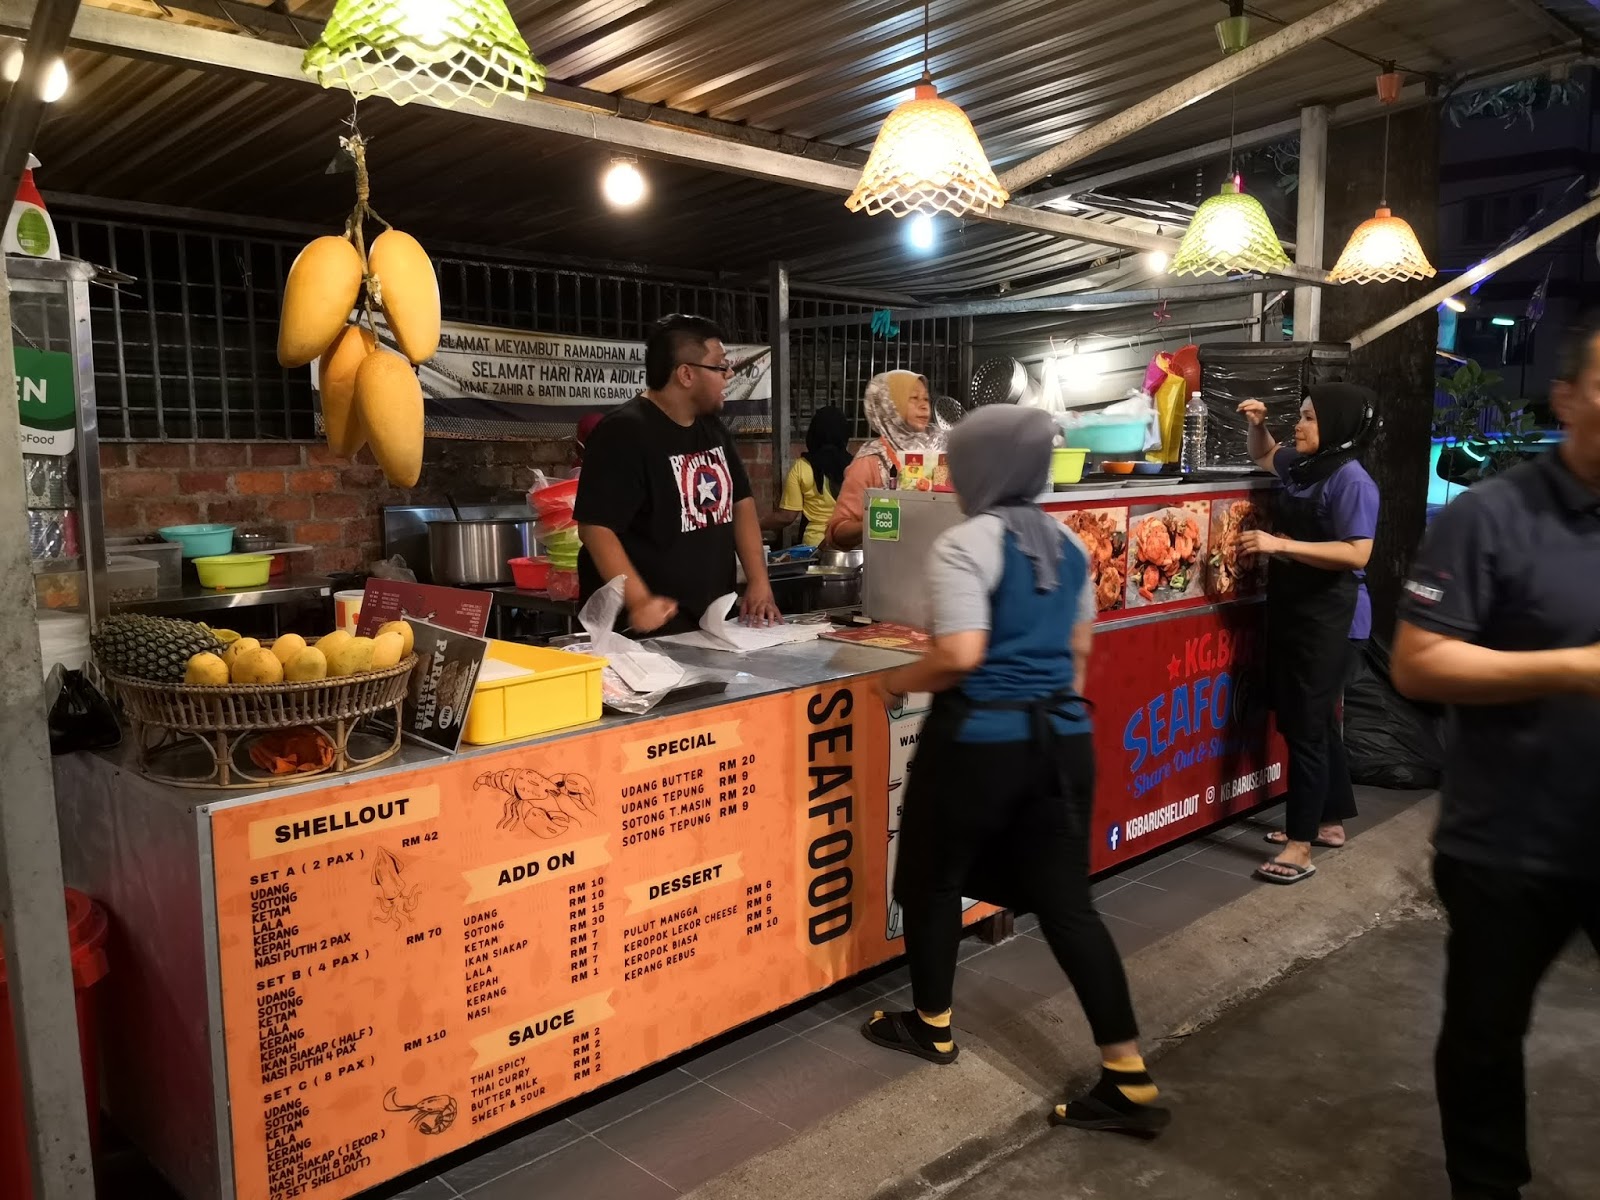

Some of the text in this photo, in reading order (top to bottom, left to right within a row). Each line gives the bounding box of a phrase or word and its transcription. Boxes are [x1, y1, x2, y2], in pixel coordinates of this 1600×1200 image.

[438, 334, 646, 361] ELAMAT MEYAMBUT RAMADHAN AL-
[472, 361, 646, 384] SELAMAT HARI RAYA AIDILF
[527, 384, 535, 397] &
[539, 385, 565, 398] BATIN
[568, 386, 592, 399] DARI
[876, 511, 893, 520] Grab
[876, 520, 893, 528] Food
[1185, 628, 1236, 677] KG.B
[415, 675, 431, 730] SERIES
[422, 639, 448, 730] PARATHA
[1123, 672, 1233, 774] SEAFO
[647, 733, 716, 759] SPECIAL
[622, 754, 755, 798] UDANG BUTTER RM 20
[622, 771, 748, 814] UDANG TEPUNG RM 9
[1133, 763, 1172, 798] Share
[1173, 750, 1196, 772] Out
[1221, 762, 1281, 802] KG.BARUSEAFOOD
[275, 799, 409, 843] SHELLOUT
[622, 785, 756, 830] SOTONG T.MASIN RM 20
[622, 801, 749, 846] SOTONG TEPUNG RM 9
[807, 688, 854, 946] SEAFOOD
[1126, 794, 1200, 842] KGBARUSHELLOUT
[250, 832, 438, 885] SET PAX RM 42
[498, 851, 575, 886] ADD ON
[251, 883, 290, 901] UDANG
[251, 892, 297, 912] SOTONG
[464, 877, 604, 926] UDANG RM 10
[649, 864, 723, 900] DESSERT
[252, 906, 291, 924] KETAM
[253, 919, 284, 935] LALA
[464, 890, 604, 940] SOTONG RM 10
[464, 902, 604, 954] KETAM RM 15
[624, 884, 761, 939] PULUT MANGGA RM
[624, 898, 762, 953] KEROPOK LEKOR CHEESE RM
[254, 925, 299, 946] KERANG
[254, 940, 290, 958] KEPAH
[255, 933, 351, 969] NASI PUTIH PAX
[465, 915, 605, 967] IKAN SIAKAP RM 30
[466, 933, 586, 980] LALA RM
[625, 910, 762, 967] KEROPOK BIASA RM
[625, 917, 778, 981] KERANG REBUS RM 10
[257, 928, 442, 990] SET PAX RM 70
[466, 946, 587, 994] KEPAH RM
[257, 987, 296, 1007] UDANG
[466, 958, 587, 1007] KERANG RM
[468, 971, 588, 1021] NASI RM
[258, 997, 303, 1018] SOTONG
[258, 1010, 296, 1029] KETAM
[508, 1010, 575, 1046] SAUCE
[259, 1023, 289, 1040] LALA
[260, 1029, 305, 1051] KERANG
[260, 1042, 296, 1063] KEPAH
[261, 1030, 365, 1073] IKAN SIAKAP HALF
[262, 1043, 356, 1084] NASI PUTIH PAX
[264, 1030, 447, 1104] SET PAX RM 110
[471, 1032, 589, 1084] THAI SPICY RM
[471, 1044, 590, 1098] THAI CURRY RM
[472, 1056, 590, 1112] BUTTER MILK RM
[472, 1068, 590, 1124] SWEET & SOUR RM
[265, 1098, 302, 1119] UDANG
[265, 1107, 309, 1130] SOTONG
[266, 1120, 303, 1141] KETAM
[267, 1134, 296, 1152] LALA
[267, 1138, 311, 1163] KERANG
[268, 1153, 303, 1174] KEPAH
[269, 1134, 379, 1184] IKAN SIAKAP EKOR
[269, 1150, 362, 1195] NASI PUTIH PAX
[286, 1184, 307, 1198] SET
[311, 1156, 370, 1189] SHELLOUT)
